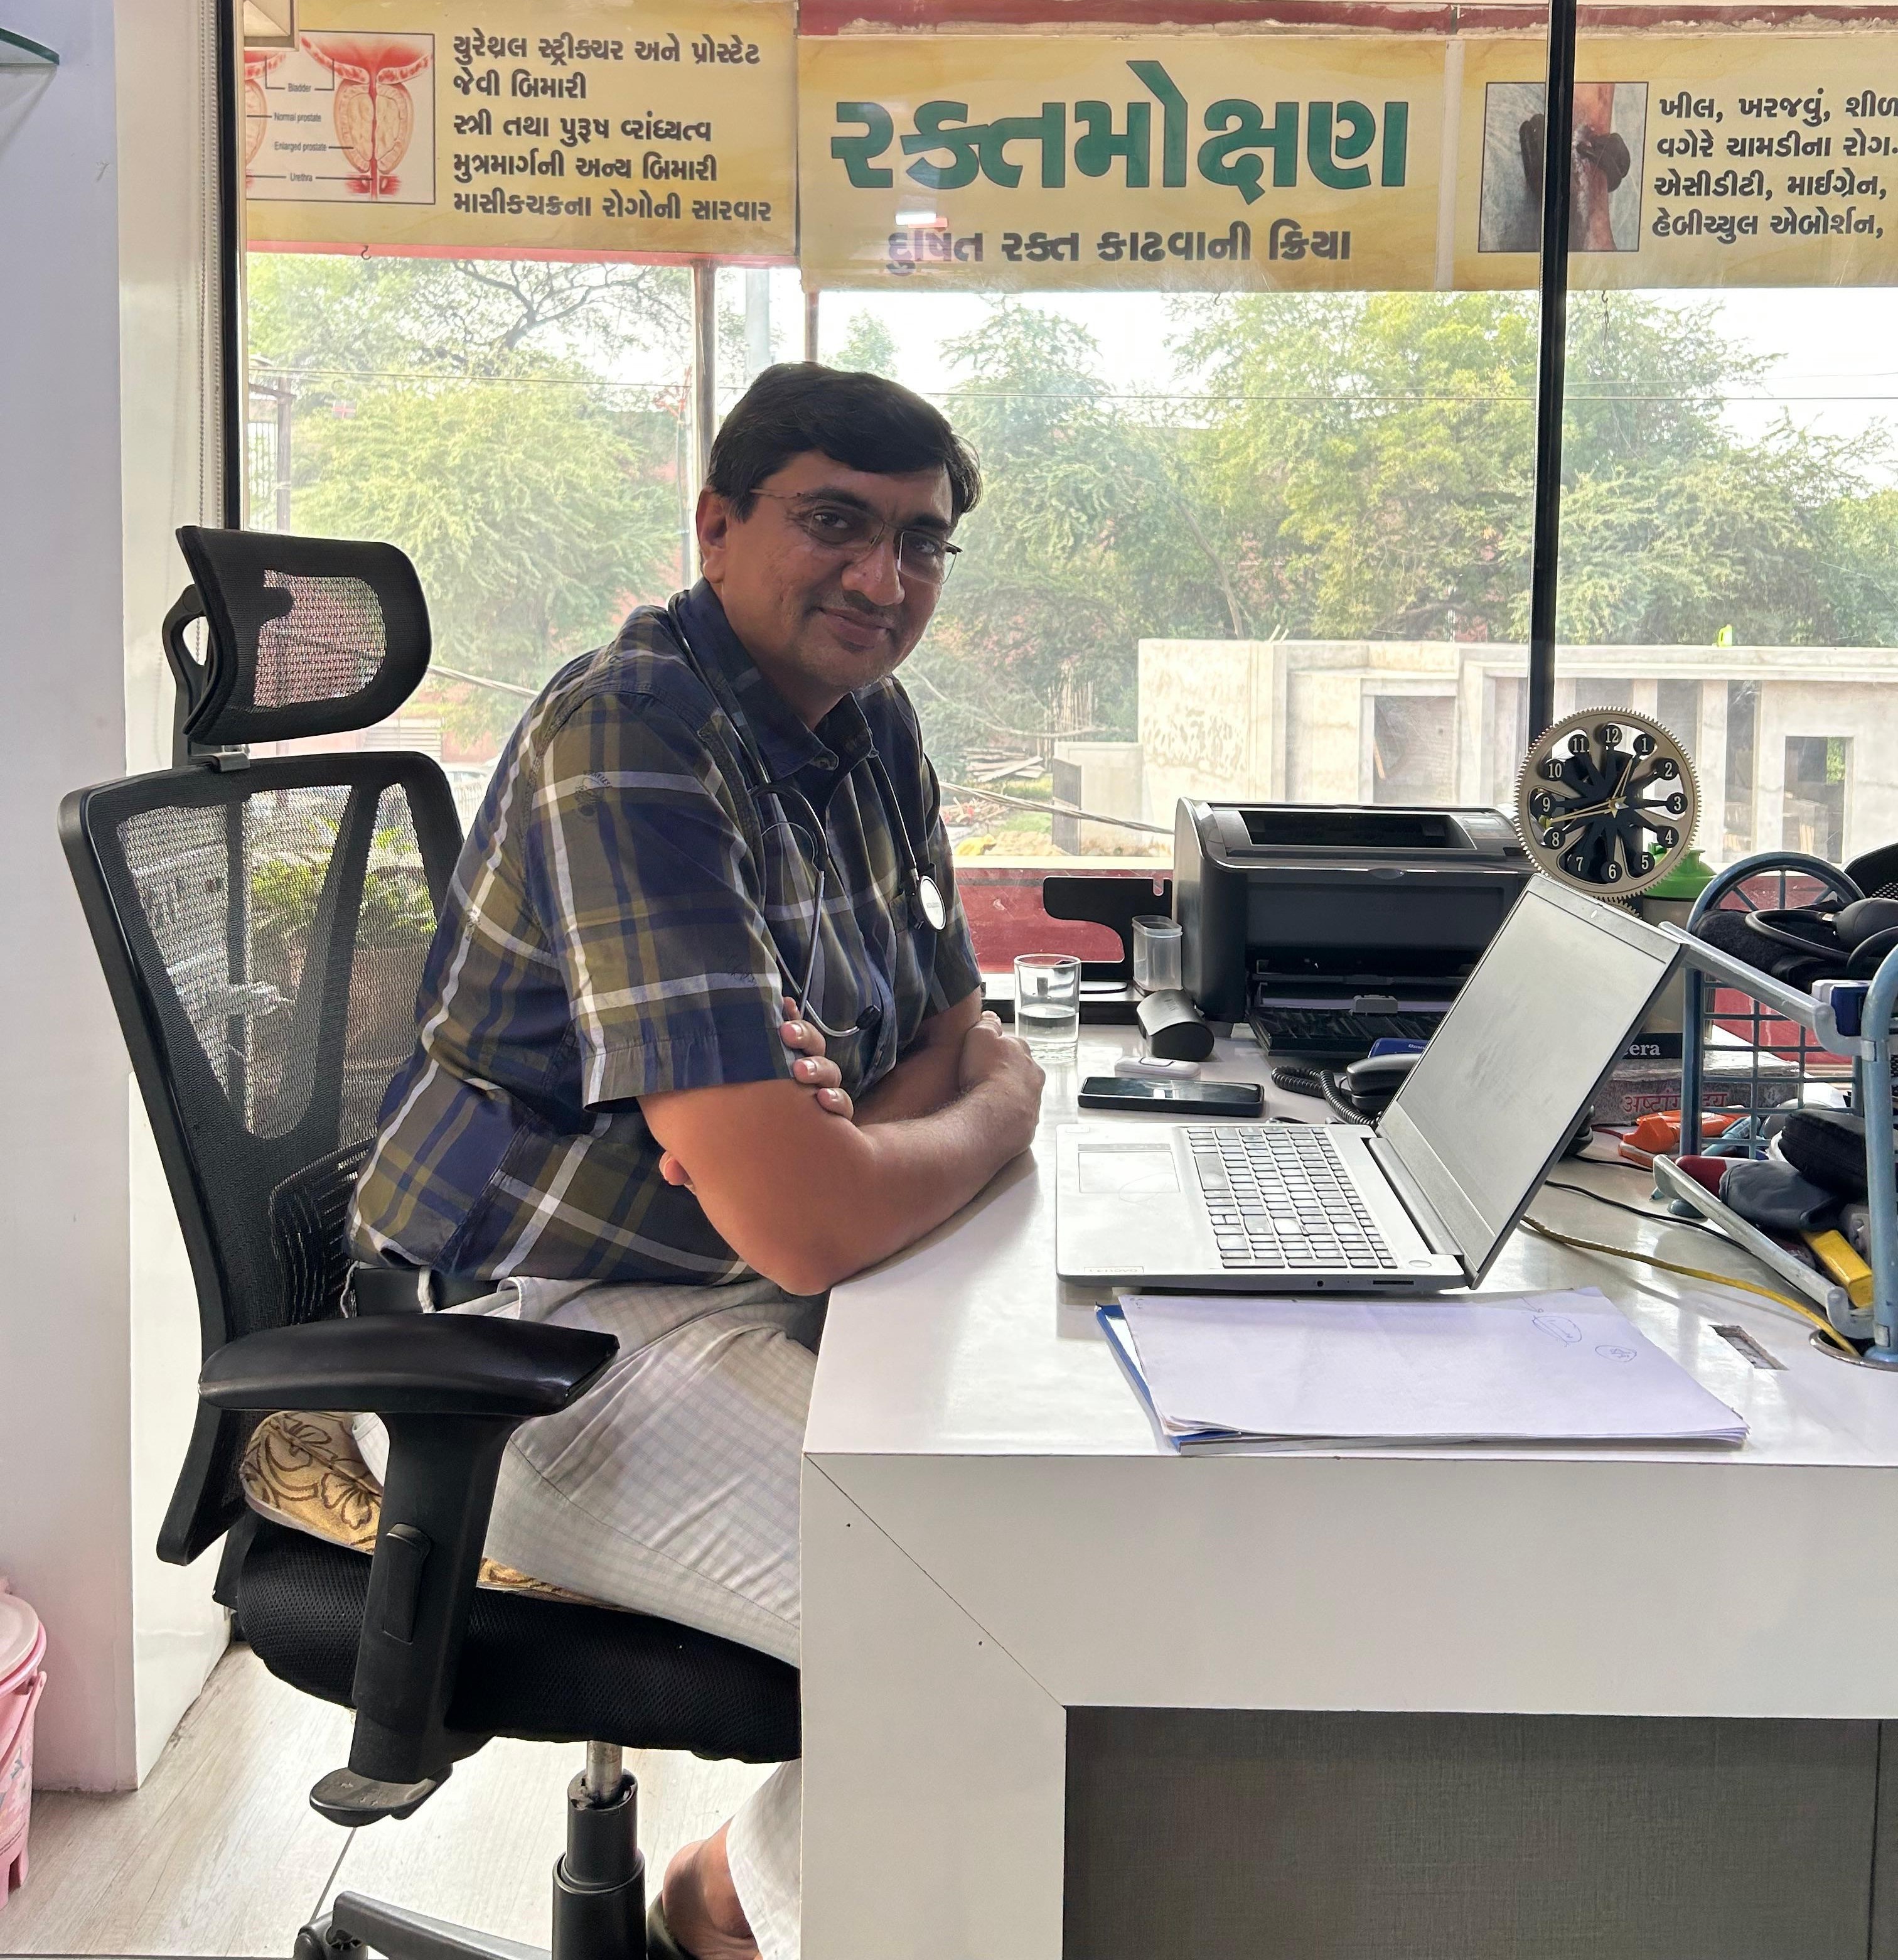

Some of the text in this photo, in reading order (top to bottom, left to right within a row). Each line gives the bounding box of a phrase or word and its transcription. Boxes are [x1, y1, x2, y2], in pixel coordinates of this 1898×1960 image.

[635, 33, 680, 62] અને
[692, 34, 759, 64] પ્રોસ્ટેટ
[288, 83, 311, 92] Bladder
[453, 67, 586, 99] જેવી બિમારી
[1659, 92, 1724, 123] ખીલ,
[1738, 87, 1830, 127] ખરજવું,
[274, 112, 321, 123] Normal prostate
[453, 108, 491, 135] સ્ત્રી
[503, 116, 549, 137] તથા
[830, 60, 1409, 205] રક્તમોક્ષણ
[274, 142, 327, 153] Enlarged prostate
[1657, 129, 1714, 158] વગેરે
[1726, 130, 1831, 158] ચામડીના
[454, 148, 717, 183] મુત્રમાર્ગની અન્ય બિમારી
[290, 173, 313, 182] Urethra
[1654, 167, 1887, 201] એસીડીટી, માઈગ્રેન,
[454, 187, 771, 222] માસીકચક્રના રોગોની સારવાર
[1769, 206, 1884, 239] એબોર્શન,
[1001, 232, 1079, 262] રક્ત
[1096, 220, 1251, 262] કાઢવાની
[1269, 218, 1351, 261] ક્રિયા
[1606, 728, 1619, 743] 12
[1572, 738, 1585, 753] 11
[1641, 738, 1648, 752] 1
[1548, 763, 1562, 778] 10
[1665, 762, 1673, 777] 2
[1542, 797, 1550, 812] 9
[1673, 797, 1681, 811] 3
[1552, 832, 1560, 847] 8
[1665, 829, 1673, 844] 4
[1576, 856, 1584, 871] 7
[1641, 855, 1649, 870] 5
[1608, 864, 1617, 879] 6
[1624, 1043, 1661, 1056] era
